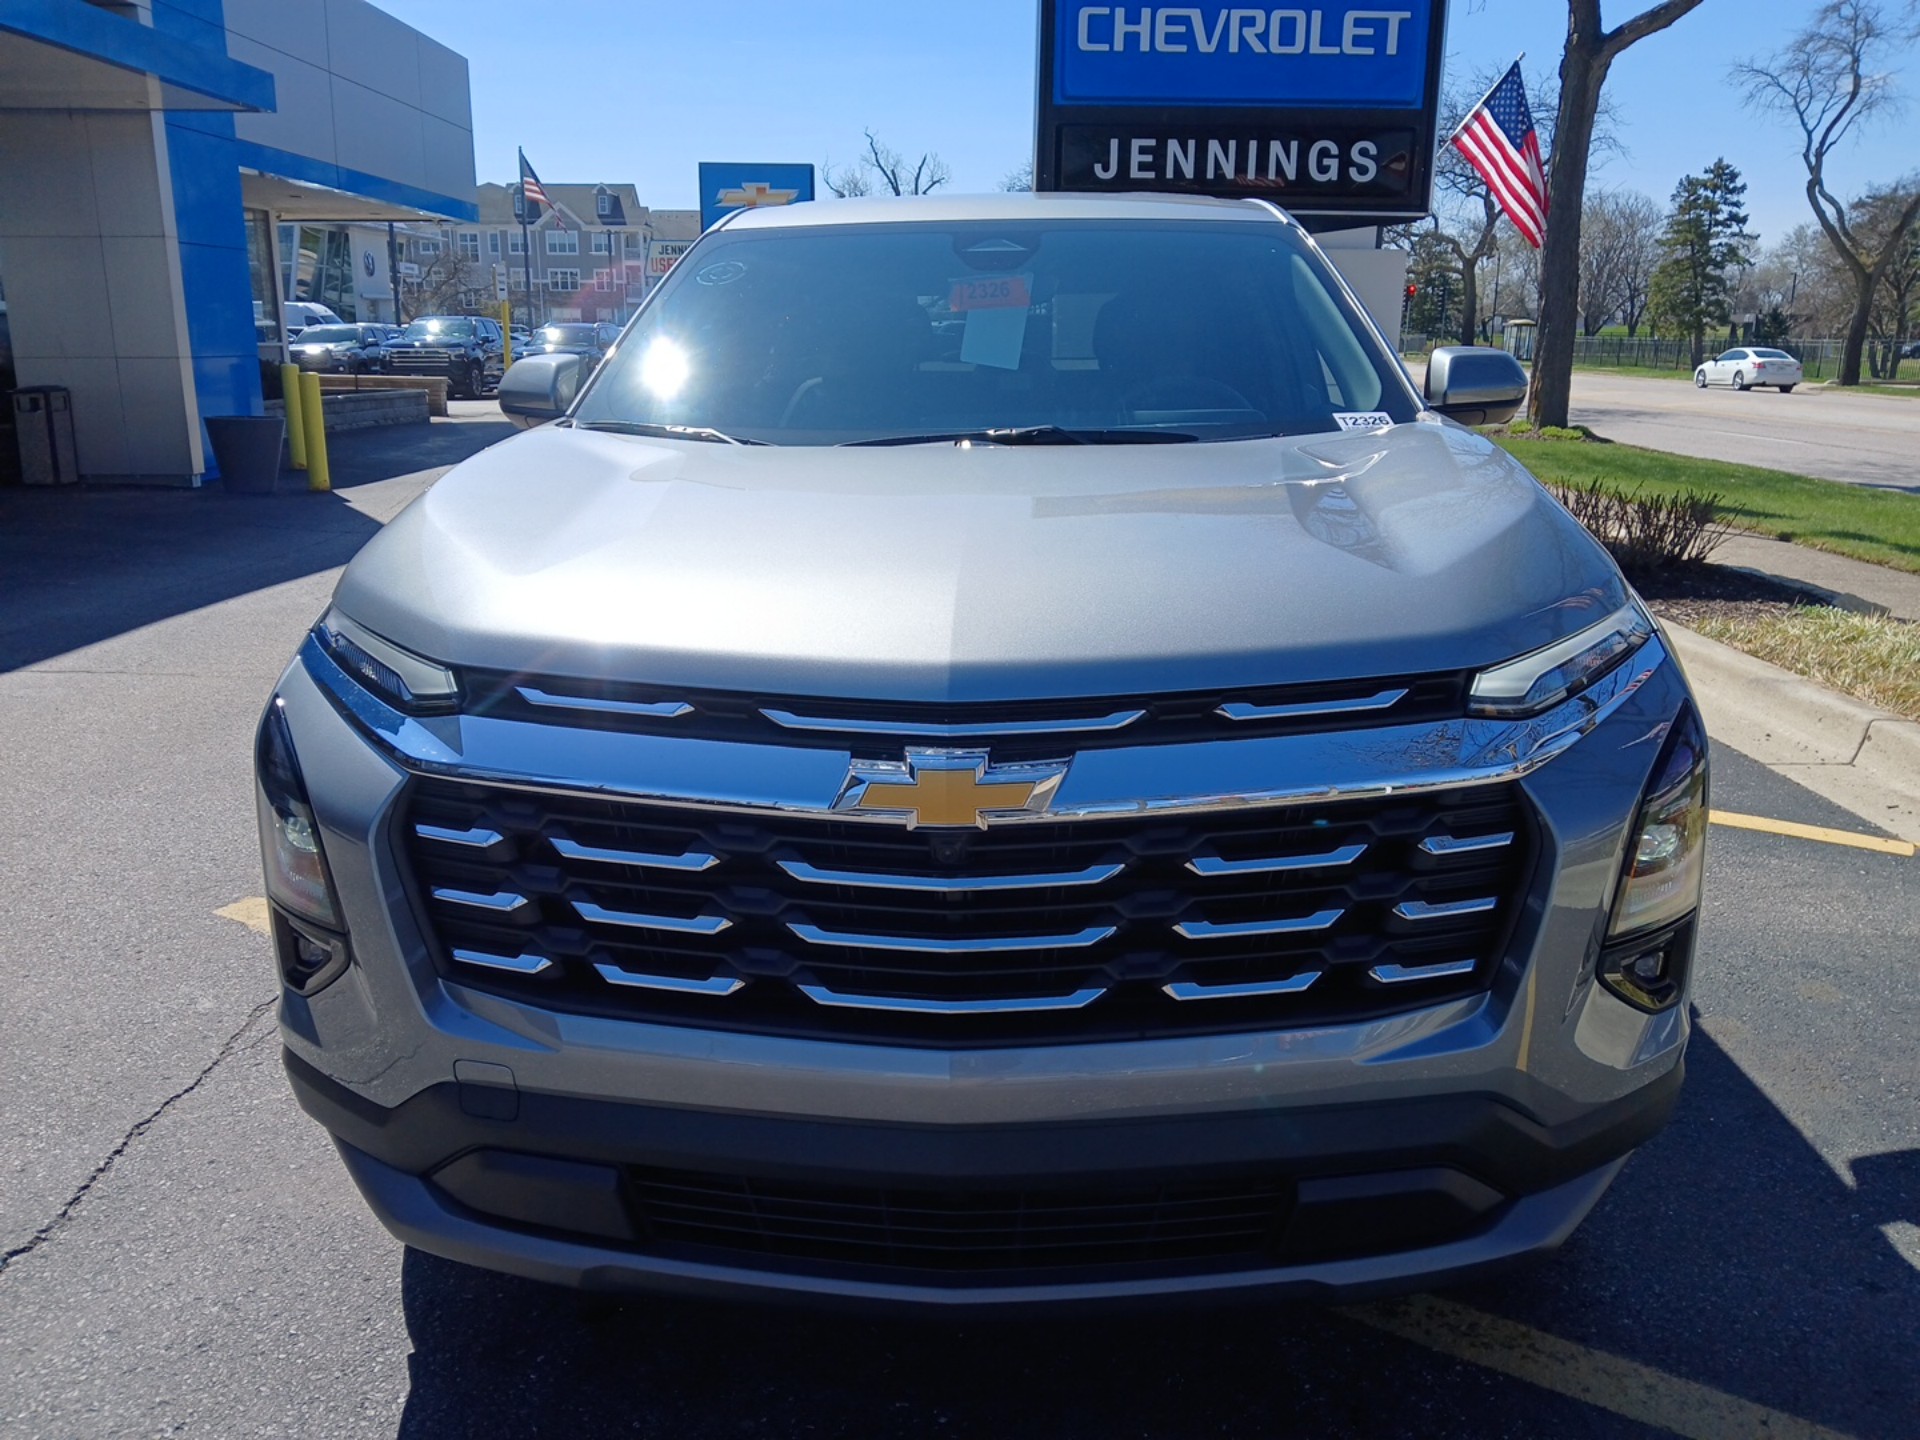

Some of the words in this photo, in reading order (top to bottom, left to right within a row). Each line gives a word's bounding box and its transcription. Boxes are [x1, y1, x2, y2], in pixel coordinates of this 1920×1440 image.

[1077, 6, 1411, 55] CHEVROLET
[1094, 138, 1378, 182] JENNINGS
[651, 257, 678, 273] USE
[1338, 415, 1390, 426] T2326
